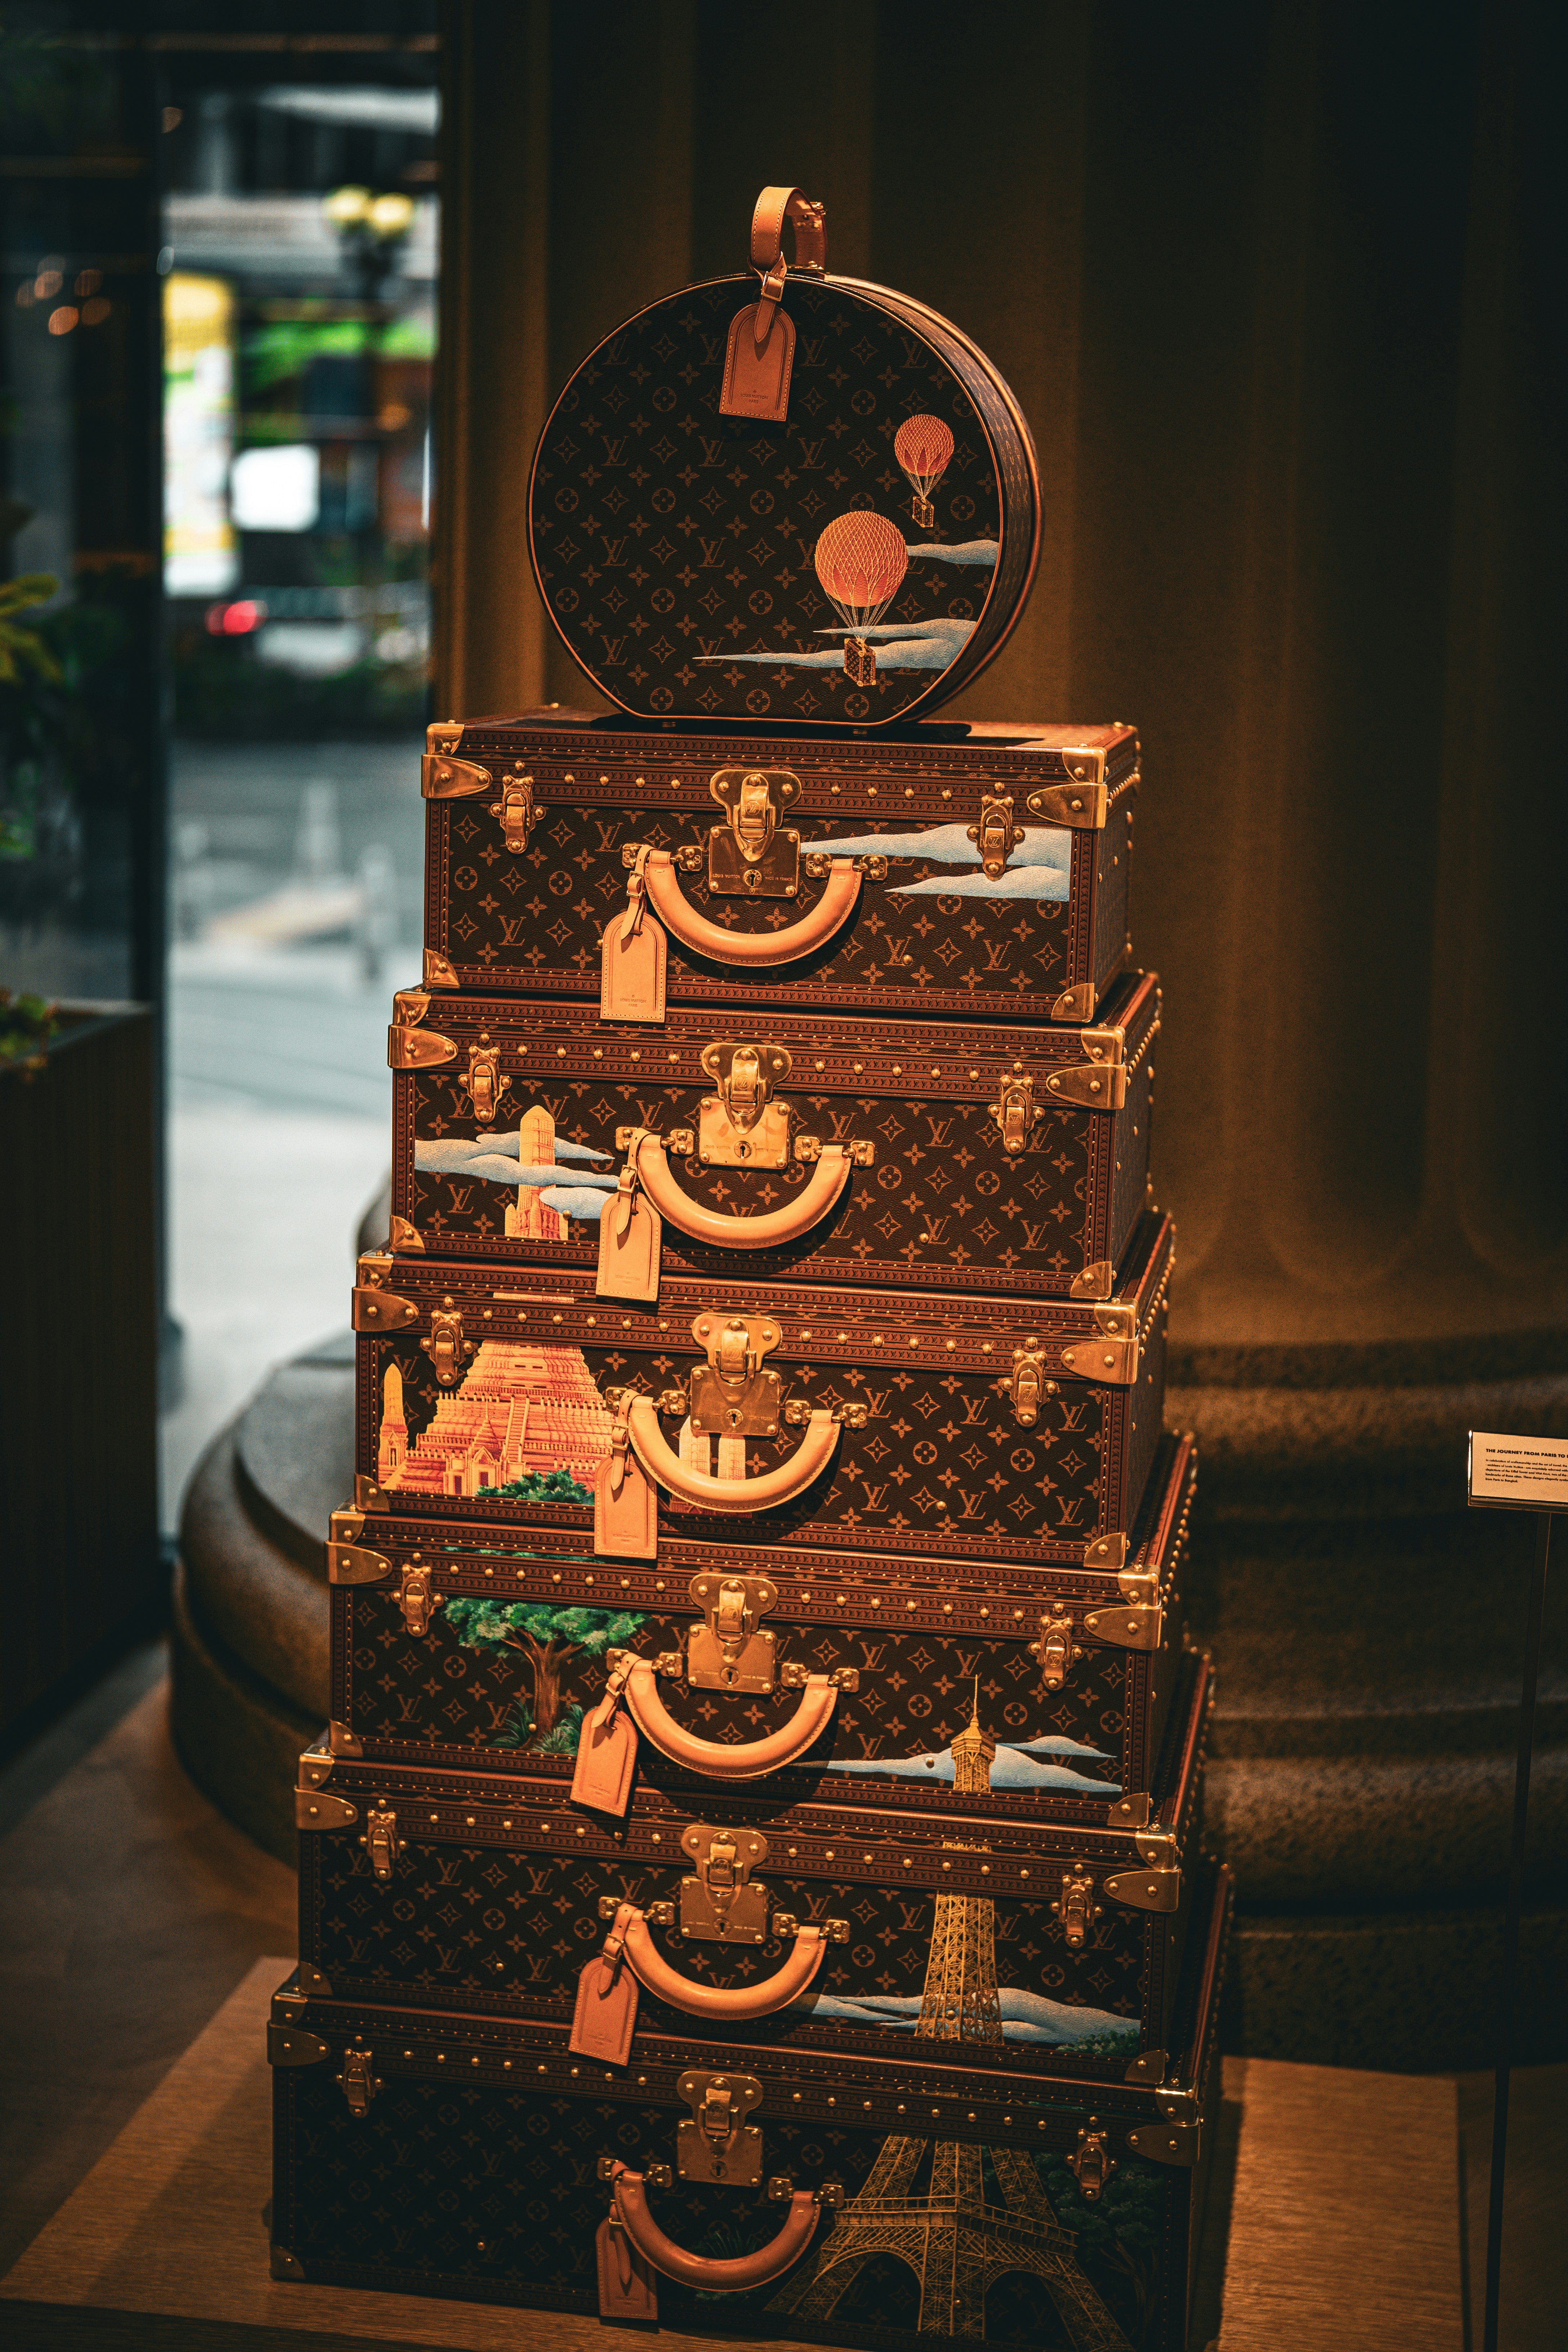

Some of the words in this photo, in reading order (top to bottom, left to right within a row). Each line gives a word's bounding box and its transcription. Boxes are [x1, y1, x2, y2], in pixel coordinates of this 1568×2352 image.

[602, 334, 630, 365] LV
[699, 334, 727, 365] LV
[800, 335, 827, 367] LV
[901, 337, 929, 368] LV
[601, 436, 630, 466] LV
[698, 436, 727, 466] LV
[798, 438, 827, 469] LV
[600, 536, 629, 566] LV
[697, 537, 727, 567] LV
[600, 635, 629, 665] LV
[595, 821, 623, 852] LV
[498, 916, 526, 946] LV
[883, 935, 913, 966] LV
[982, 940, 1012, 971] LV
[448, 1088, 474, 1118] LV
[636, 1100, 664, 1130] LV
[828, 1112, 856, 1141] LV
[925, 1117, 954, 1147] LV
[448, 1184, 474, 1214] LV
[923, 1214, 951, 1244] LV
[1020, 1220, 1050, 1251] LV
[866, 1388, 892, 1418] LV
[960, 1395, 990, 1425] LV
[1058, 1401, 1087, 1432] LV
[861, 1482, 890, 1512] LV
[958, 1489, 987, 1520] LV
[1056, 1496, 1085, 1526] LV
[859, 1642, 887, 1671] LV
[955, 1650, 983, 1678] LV
[397, 1694, 423, 1723] LV
[486, 1701, 513, 1730] LV
[436, 1857, 462, 1886] LV
[527, 1866, 553, 1895] LV
[618, 1875, 645, 1904] LV
[804, 1893, 831, 1920] LV
[898, 1902, 926, 1932] LV
[995, 1912, 1021, 1941] LV
[1087, 1923, 1118, 1950] LV
[346, 1935, 372, 1963] LV
[435, 1945, 461, 1972] LV
[526, 1954, 553, 1982] LV
[392, 2138, 417, 2167] LV
[480, 2148, 506, 2177] LV
[570, 2159, 595, 2187] LV
[391, 2225, 416, 2253] LV
